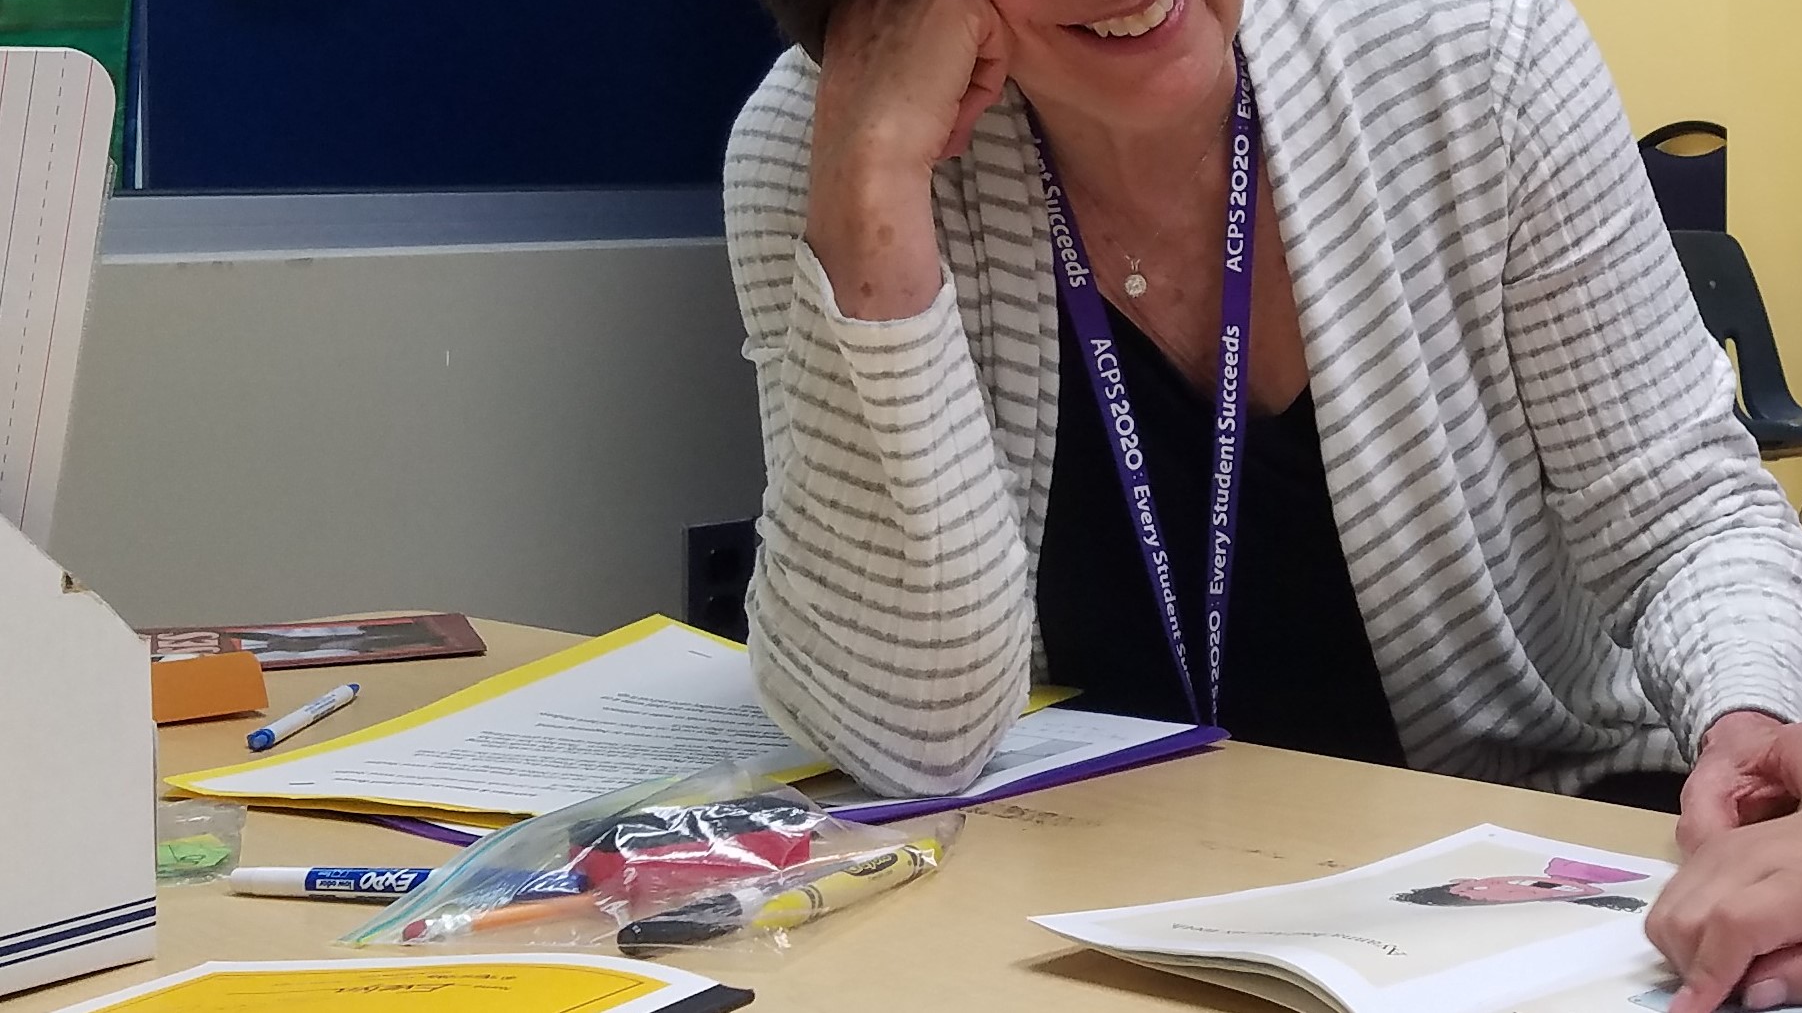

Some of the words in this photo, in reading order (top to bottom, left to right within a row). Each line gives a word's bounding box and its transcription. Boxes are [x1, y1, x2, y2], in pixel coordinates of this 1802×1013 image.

[1044, 185, 1090, 287] Succeeds
[1217, 325, 1240, 432] Succeeds
[1212, 434, 1236, 527] Student
[1133, 484, 1160, 547] Every
[1152, 550, 1181, 640] Student
[1209, 534, 1233, 596] Every
[359, 868, 417, 892] EXPO
